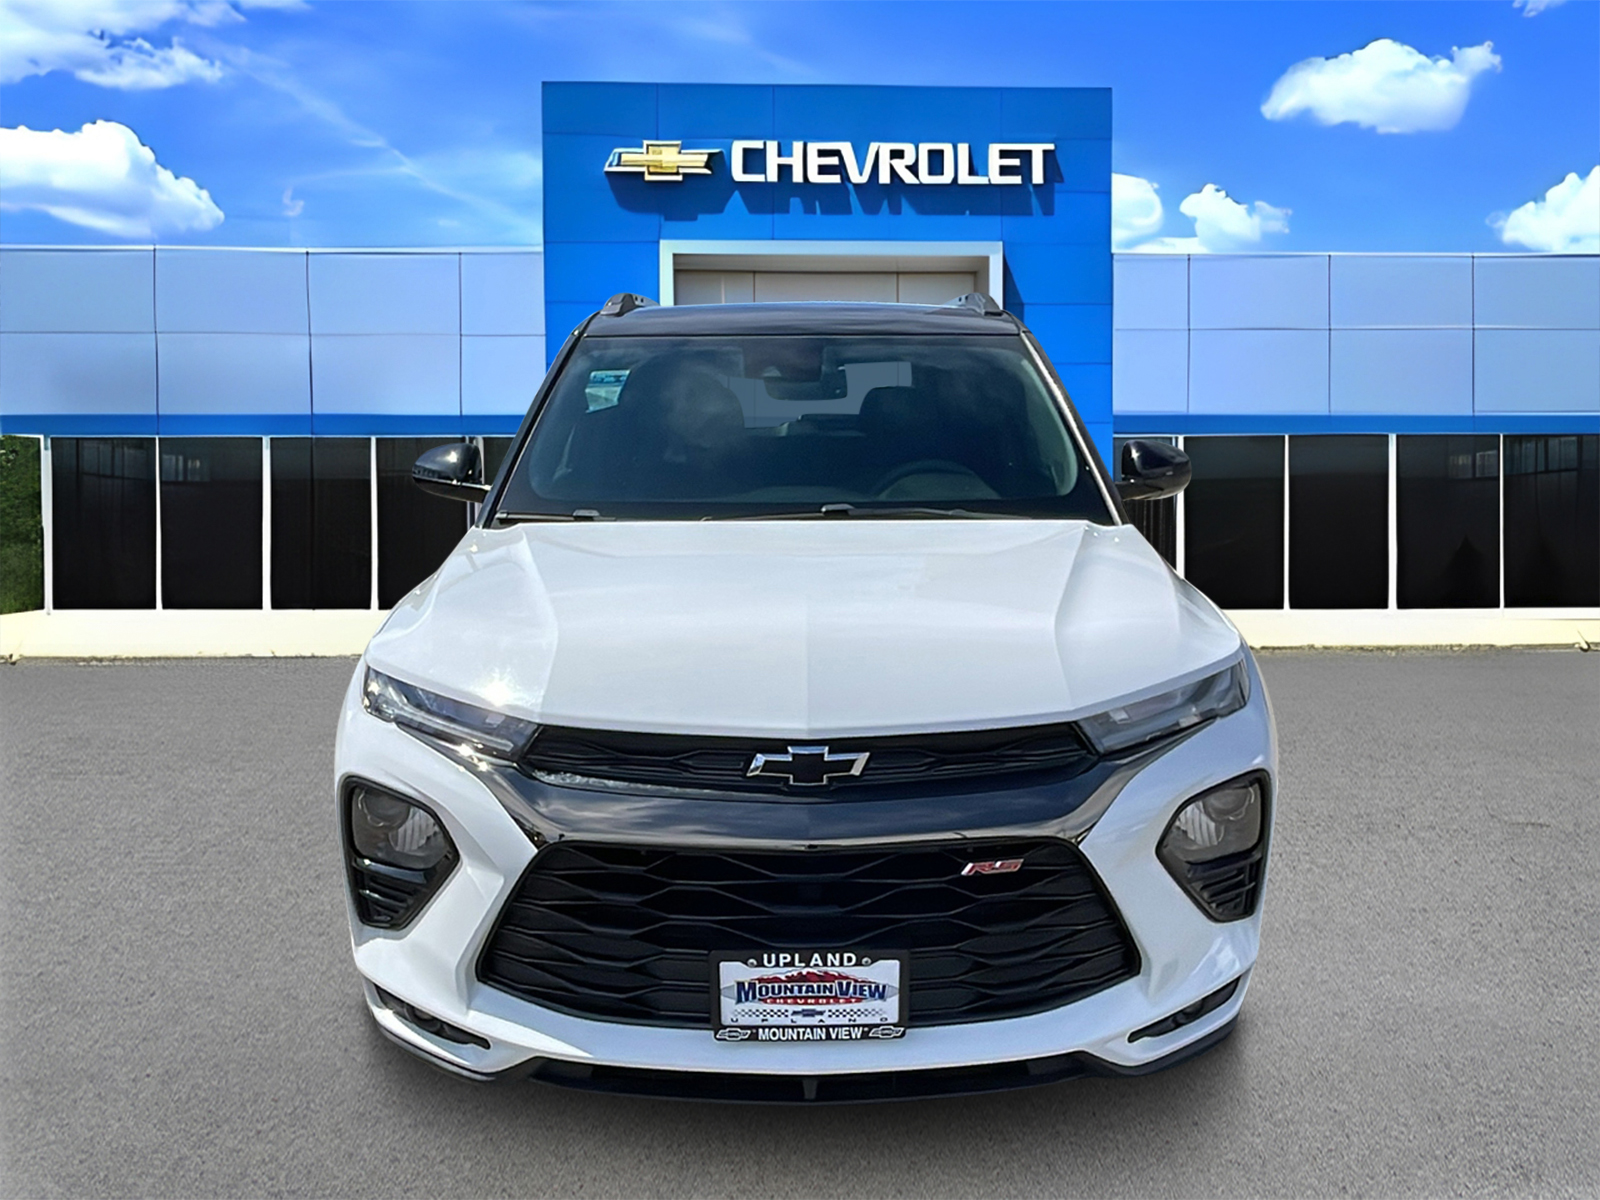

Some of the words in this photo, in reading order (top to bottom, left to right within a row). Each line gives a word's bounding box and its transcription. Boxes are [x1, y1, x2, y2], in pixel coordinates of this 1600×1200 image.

[730, 139, 1055, 186] CHEVROLET
[961, 859, 1023, 875] RS
[763, 953, 857, 967] UPLAND
[758, 1028, 825, 1041] MOUNTAIN
[830, 1027, 863, 1040] VIEW
